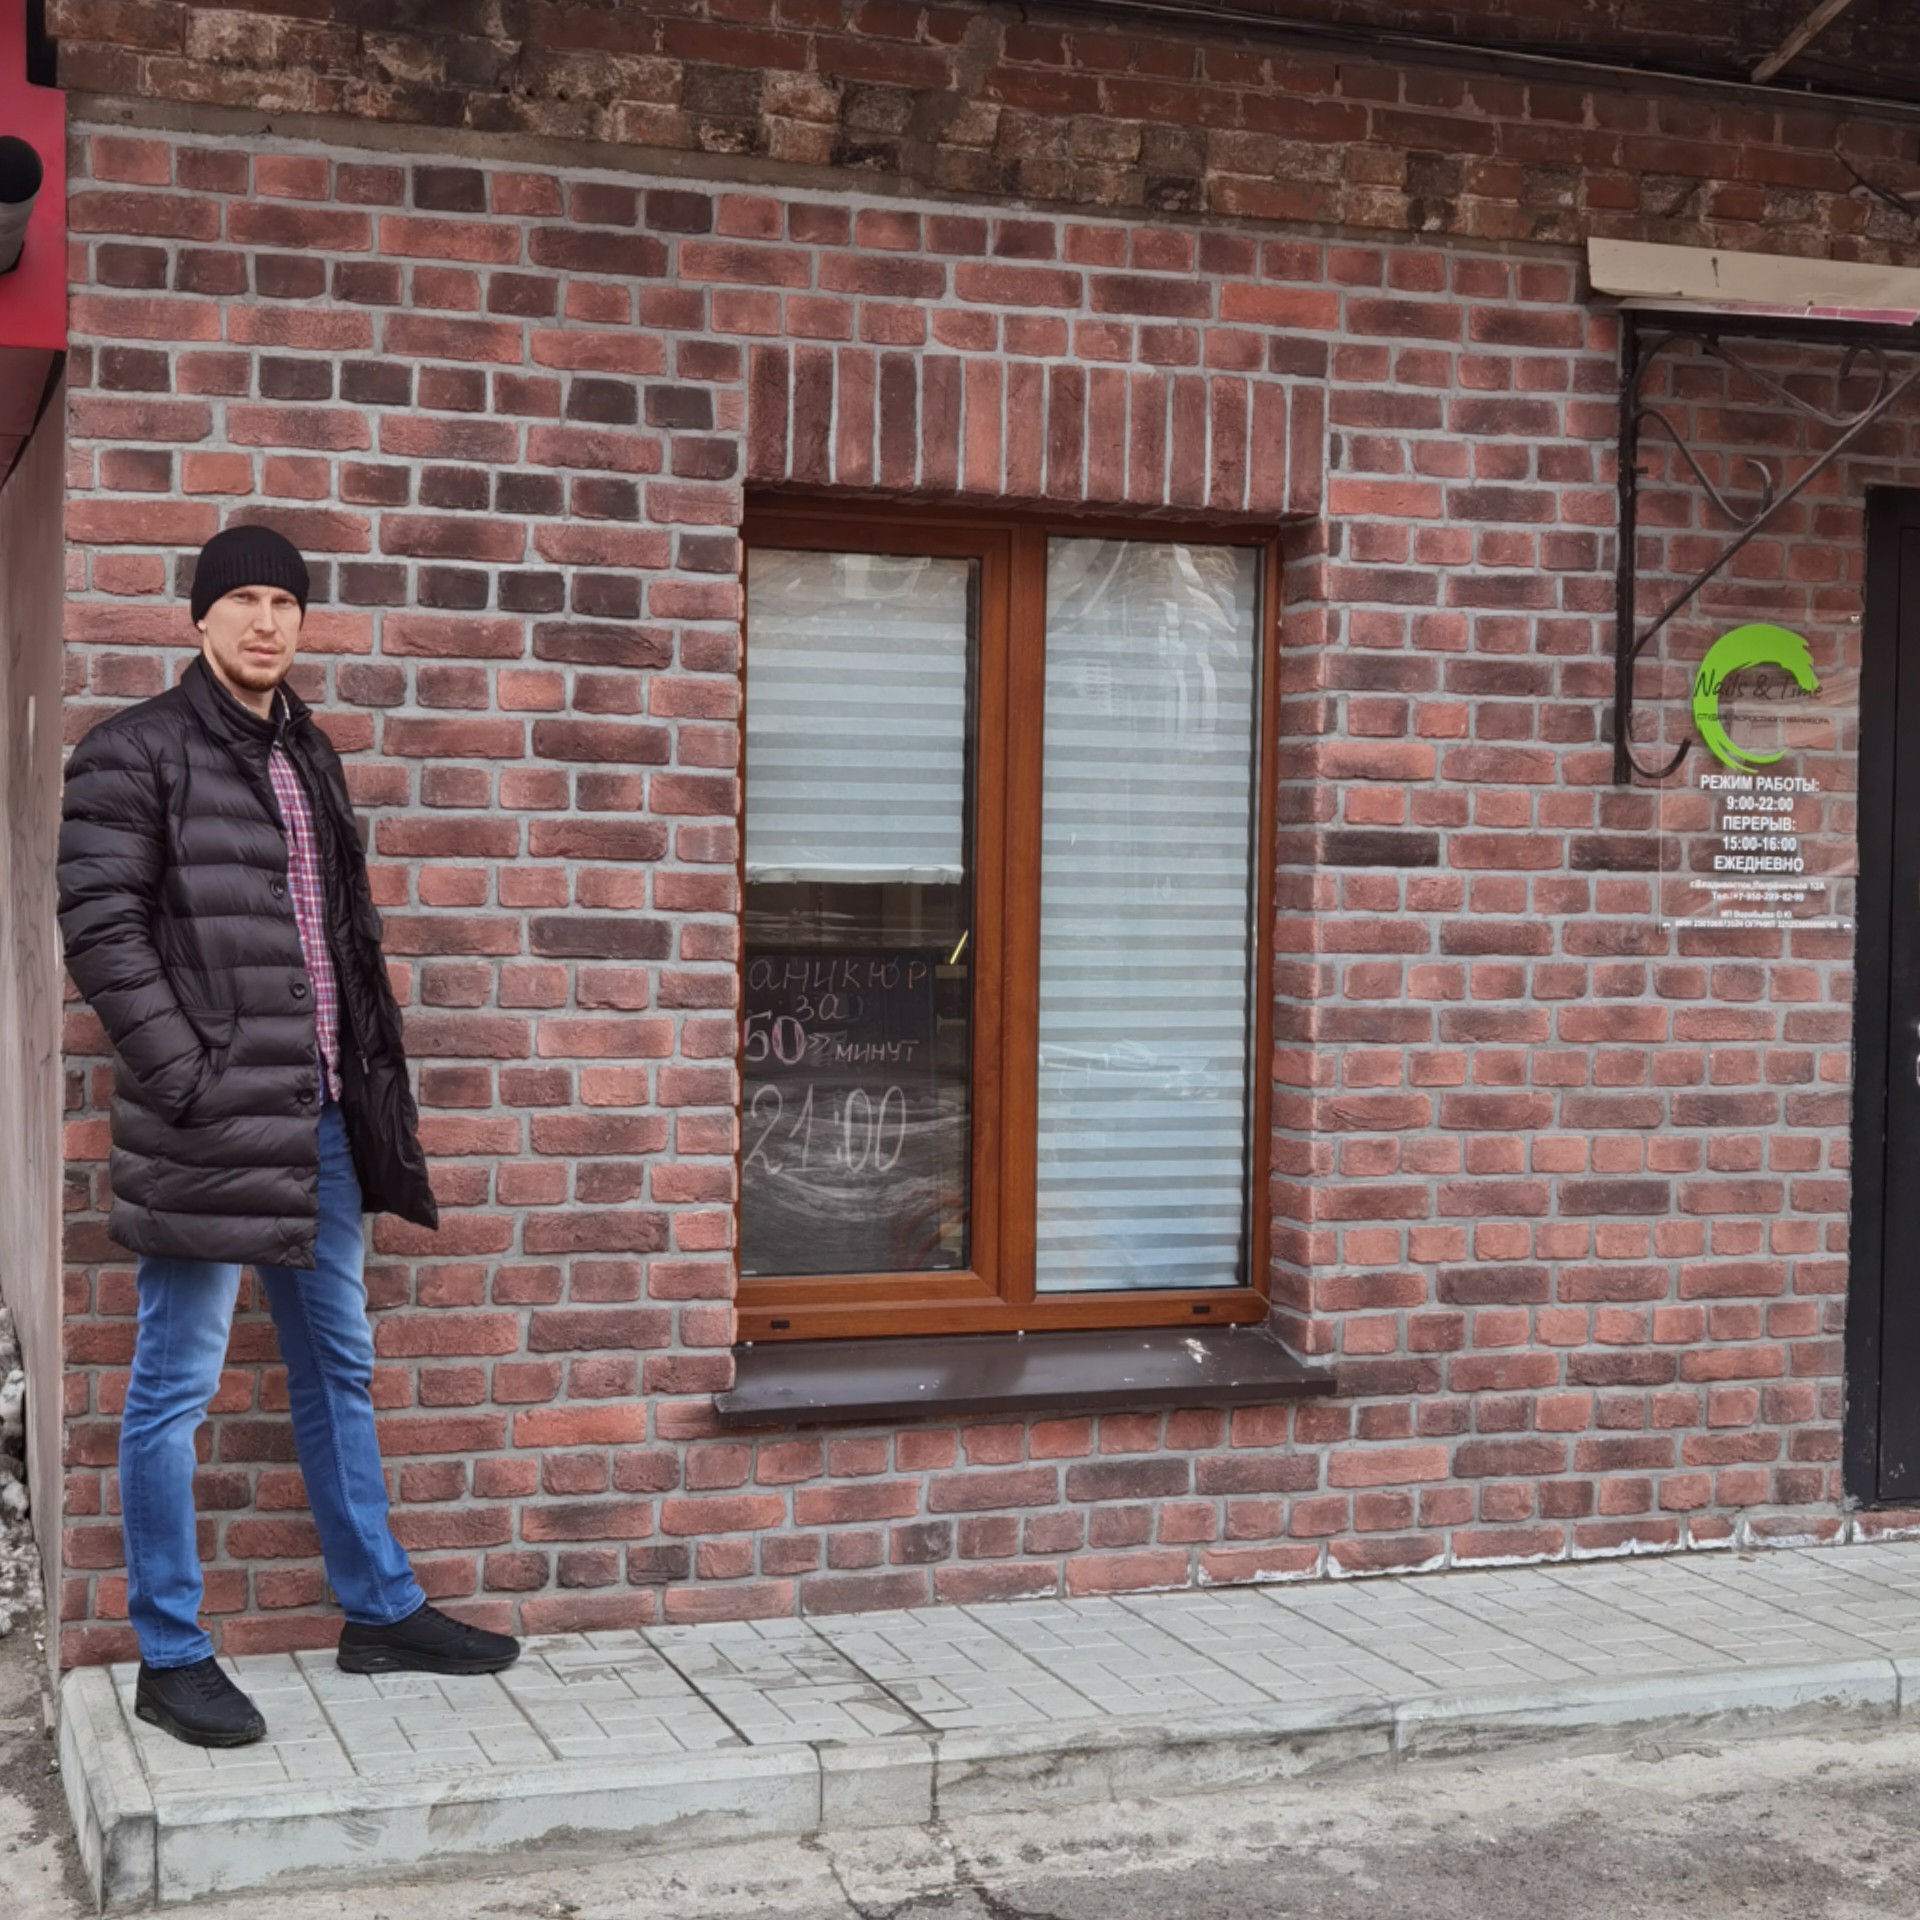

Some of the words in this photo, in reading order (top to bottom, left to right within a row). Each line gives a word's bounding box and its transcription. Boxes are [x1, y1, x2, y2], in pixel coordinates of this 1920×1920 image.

[1693, 669, 1744, 697] Nails
[1779, 673, 1824, 700] Time
[1701, 775, 1753, 790] РЕЖИМ
[1757, 777, 1820, 792] РАБОТЫ:
[1727, 796, 1794, 812] 9:00-22:00
[1723, 816, 1796, 831] ПЕРЕРЫВ:
[1723, 836, 1797, 851] 15:00-16:00
[1714, 855, 1804, 873] ЕЖЕДНЕВНО
